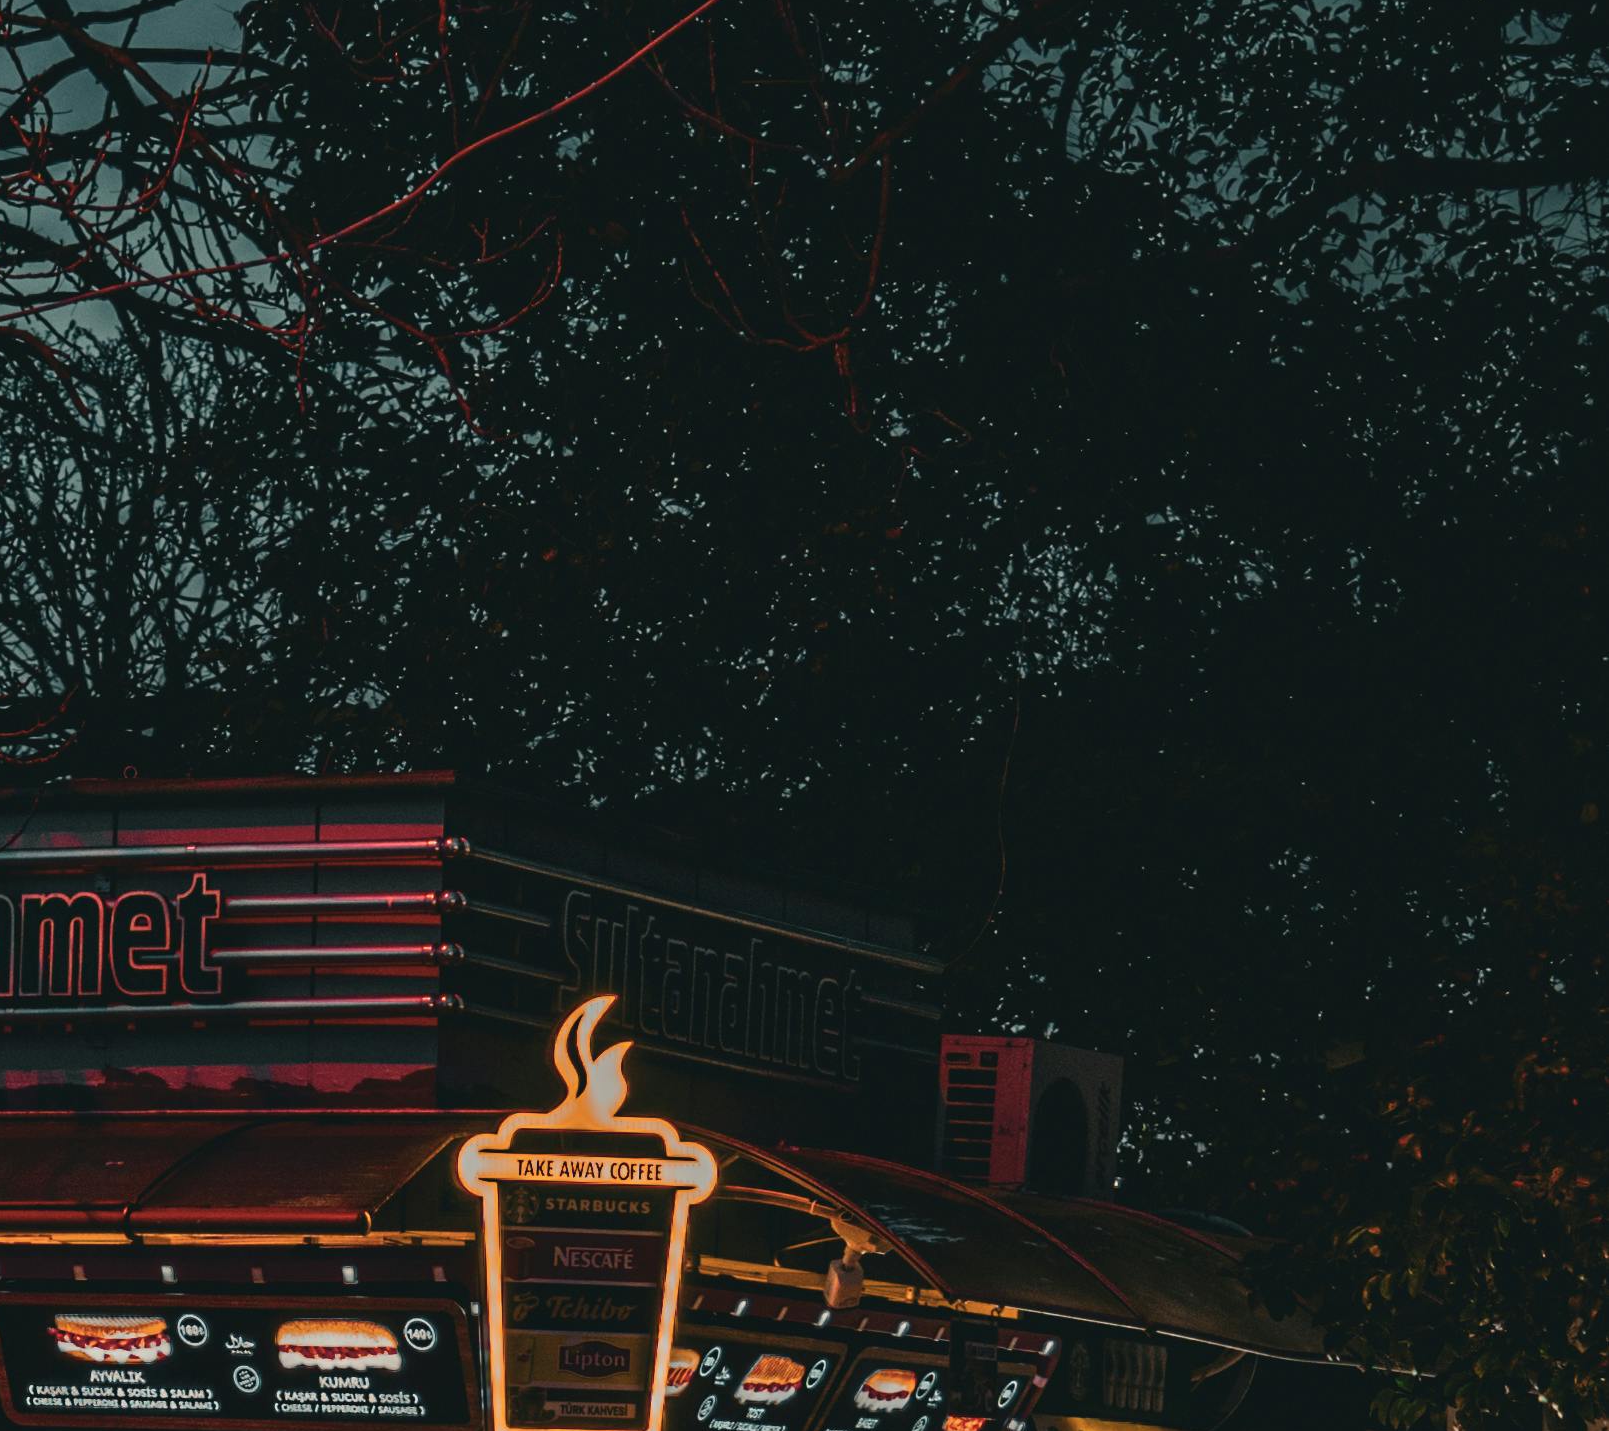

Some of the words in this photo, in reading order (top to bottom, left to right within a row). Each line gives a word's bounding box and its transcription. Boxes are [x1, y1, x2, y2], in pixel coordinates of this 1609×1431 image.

[558, 890, 861, 1082] Sultanahmet
[517, 1158, 554, 1177] TAKE
[560, 1160, 605, 1178] AWAY
[610, 1162, 663, 1181] COFFEE
[546, 1196, 651, 1214] STARBUCKS
[553, 1246, 635, 1269] NESCAFÉ
[546, 1294, 638, 1321] Tchibo
[564, 1348, 627, 1371] Lipton
[89, 1369, 146, 1384] AYVALIK
[319, 1376, 370, 1390] KUMRU
[561, 1403, 586, 1416] TÜRK
[587, 1404, 629, 1417] KAHVESİ
